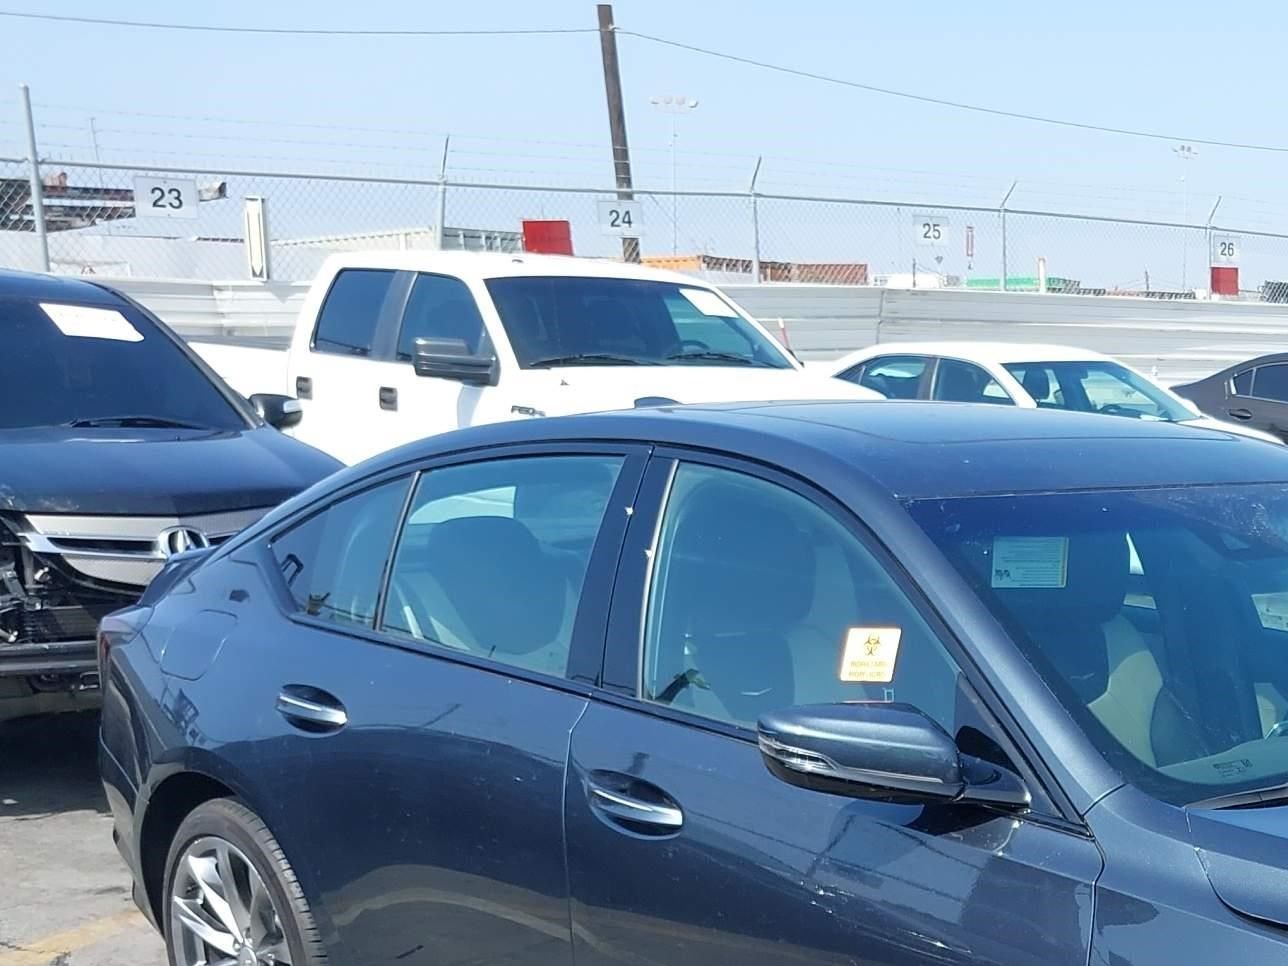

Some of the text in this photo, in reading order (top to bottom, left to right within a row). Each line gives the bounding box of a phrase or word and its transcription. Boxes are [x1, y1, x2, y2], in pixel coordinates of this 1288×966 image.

[151, 187, 182, 209] 23
[609, 209, 632, 228] 24
[923, 223, 941, 239] 25
[1220, 242, 1234, 256] 26
